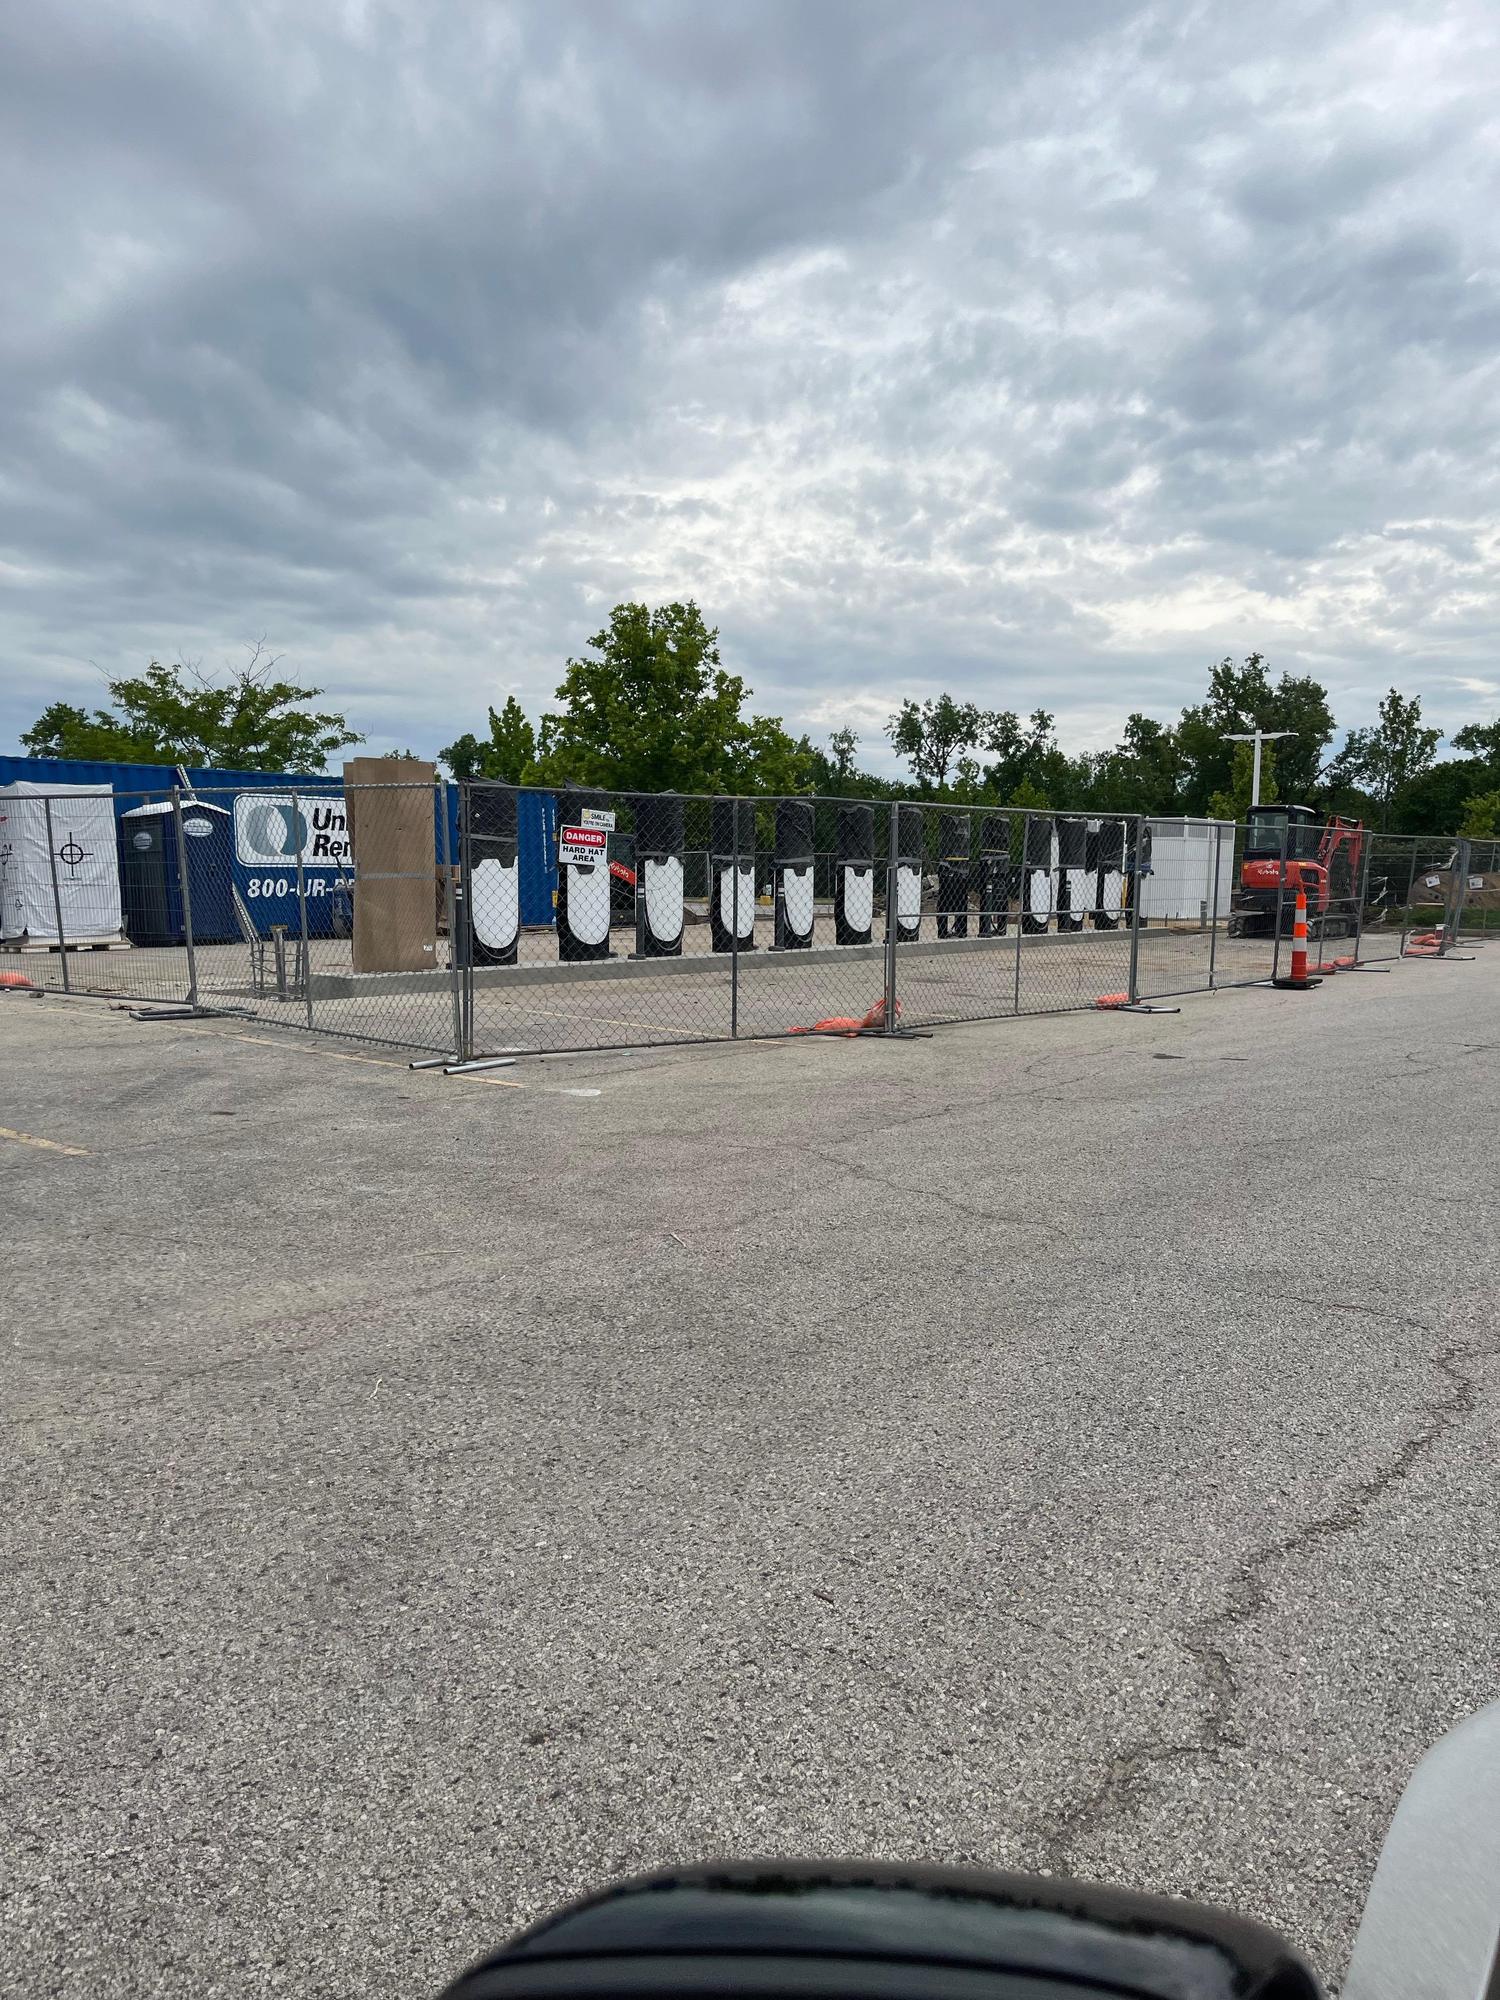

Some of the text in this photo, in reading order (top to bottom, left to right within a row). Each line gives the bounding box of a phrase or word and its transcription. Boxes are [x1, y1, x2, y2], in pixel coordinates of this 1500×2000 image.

[313, 808, 347, 831] Un
[591, 813, 606, 821] SMILE
[566, 832, 602, 843] DANGER
[563, 846, 604, 856] HARD HAT
[572, 854, 595, 863] AREA
[609, 862, 629, 878] Kubota
